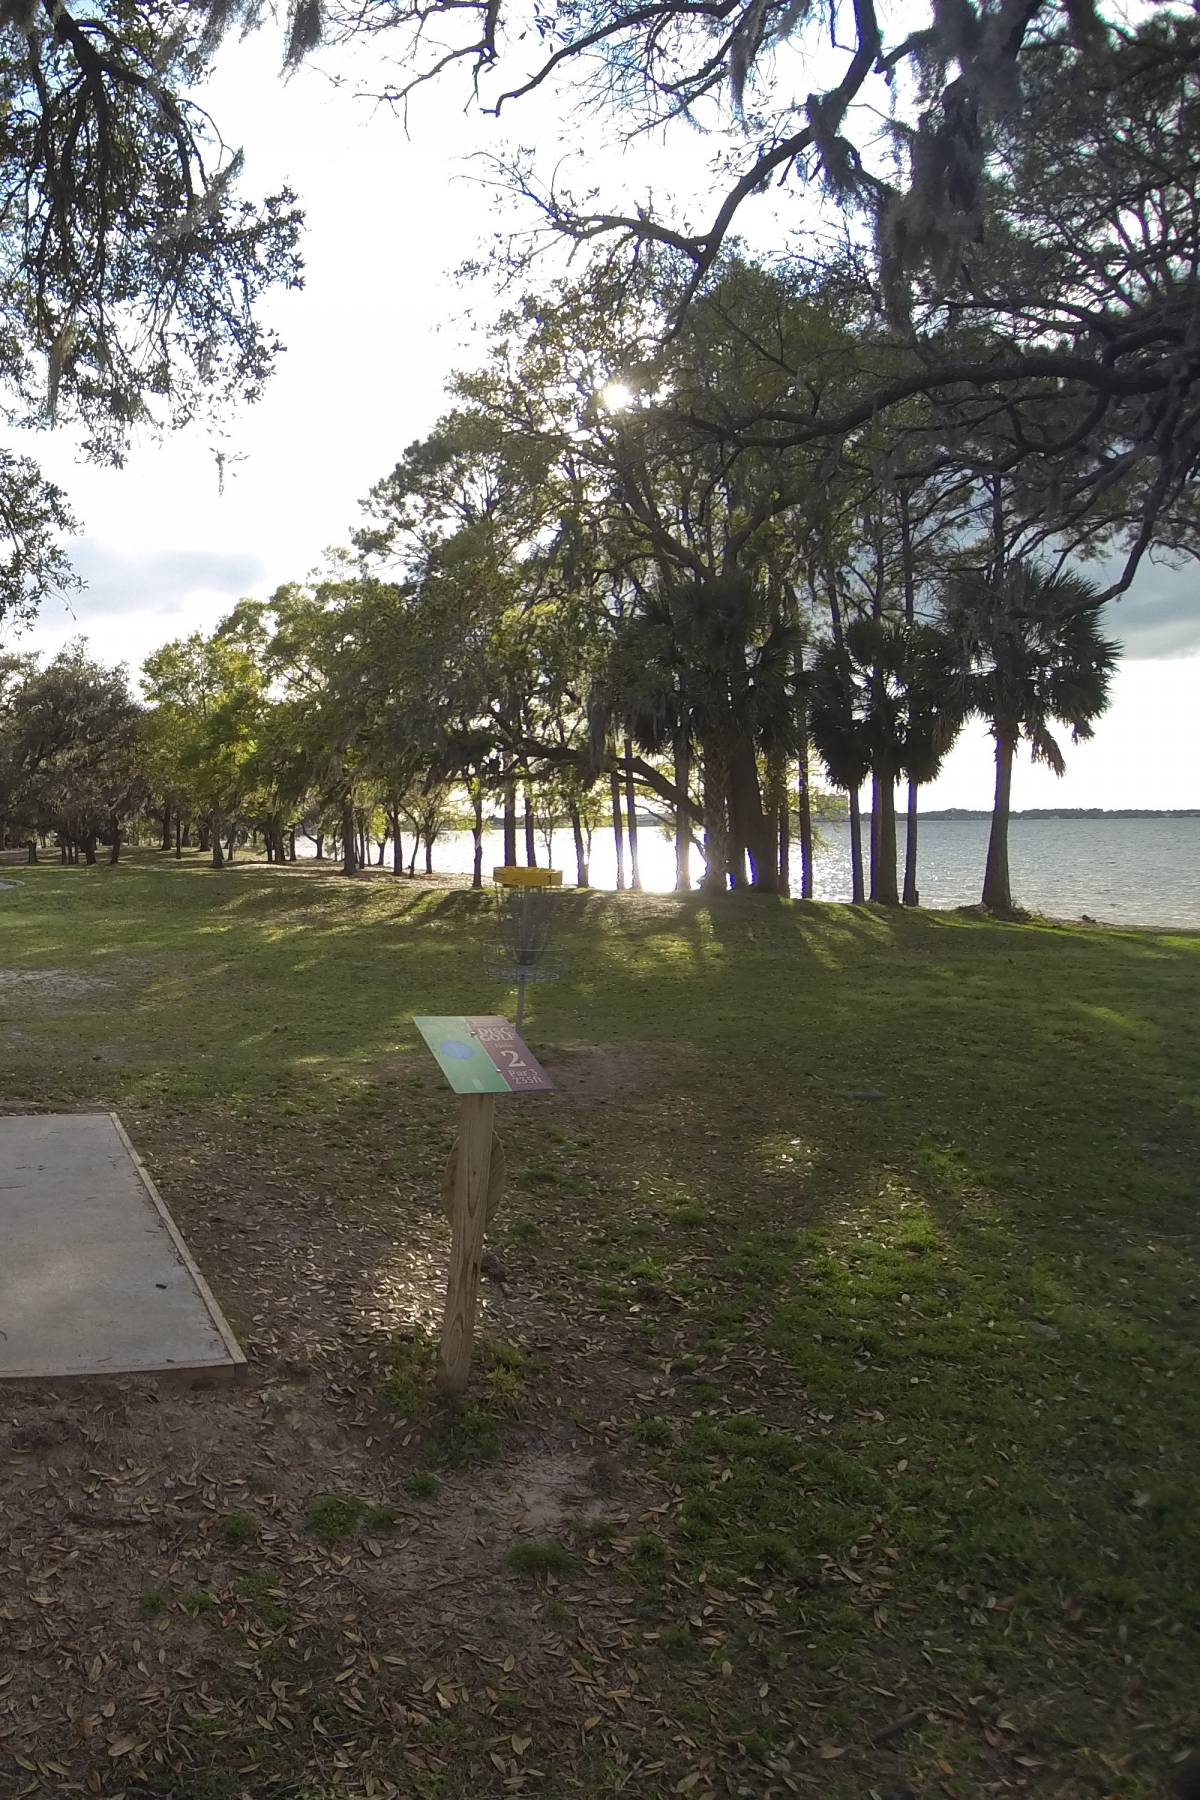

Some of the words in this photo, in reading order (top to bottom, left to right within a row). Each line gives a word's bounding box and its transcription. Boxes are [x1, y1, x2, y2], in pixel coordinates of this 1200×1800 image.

[477, 1027, 512, 1035] DISC
[500, 1050, 527, 1067] 2
[507, 1069, 527, 1077] Par
